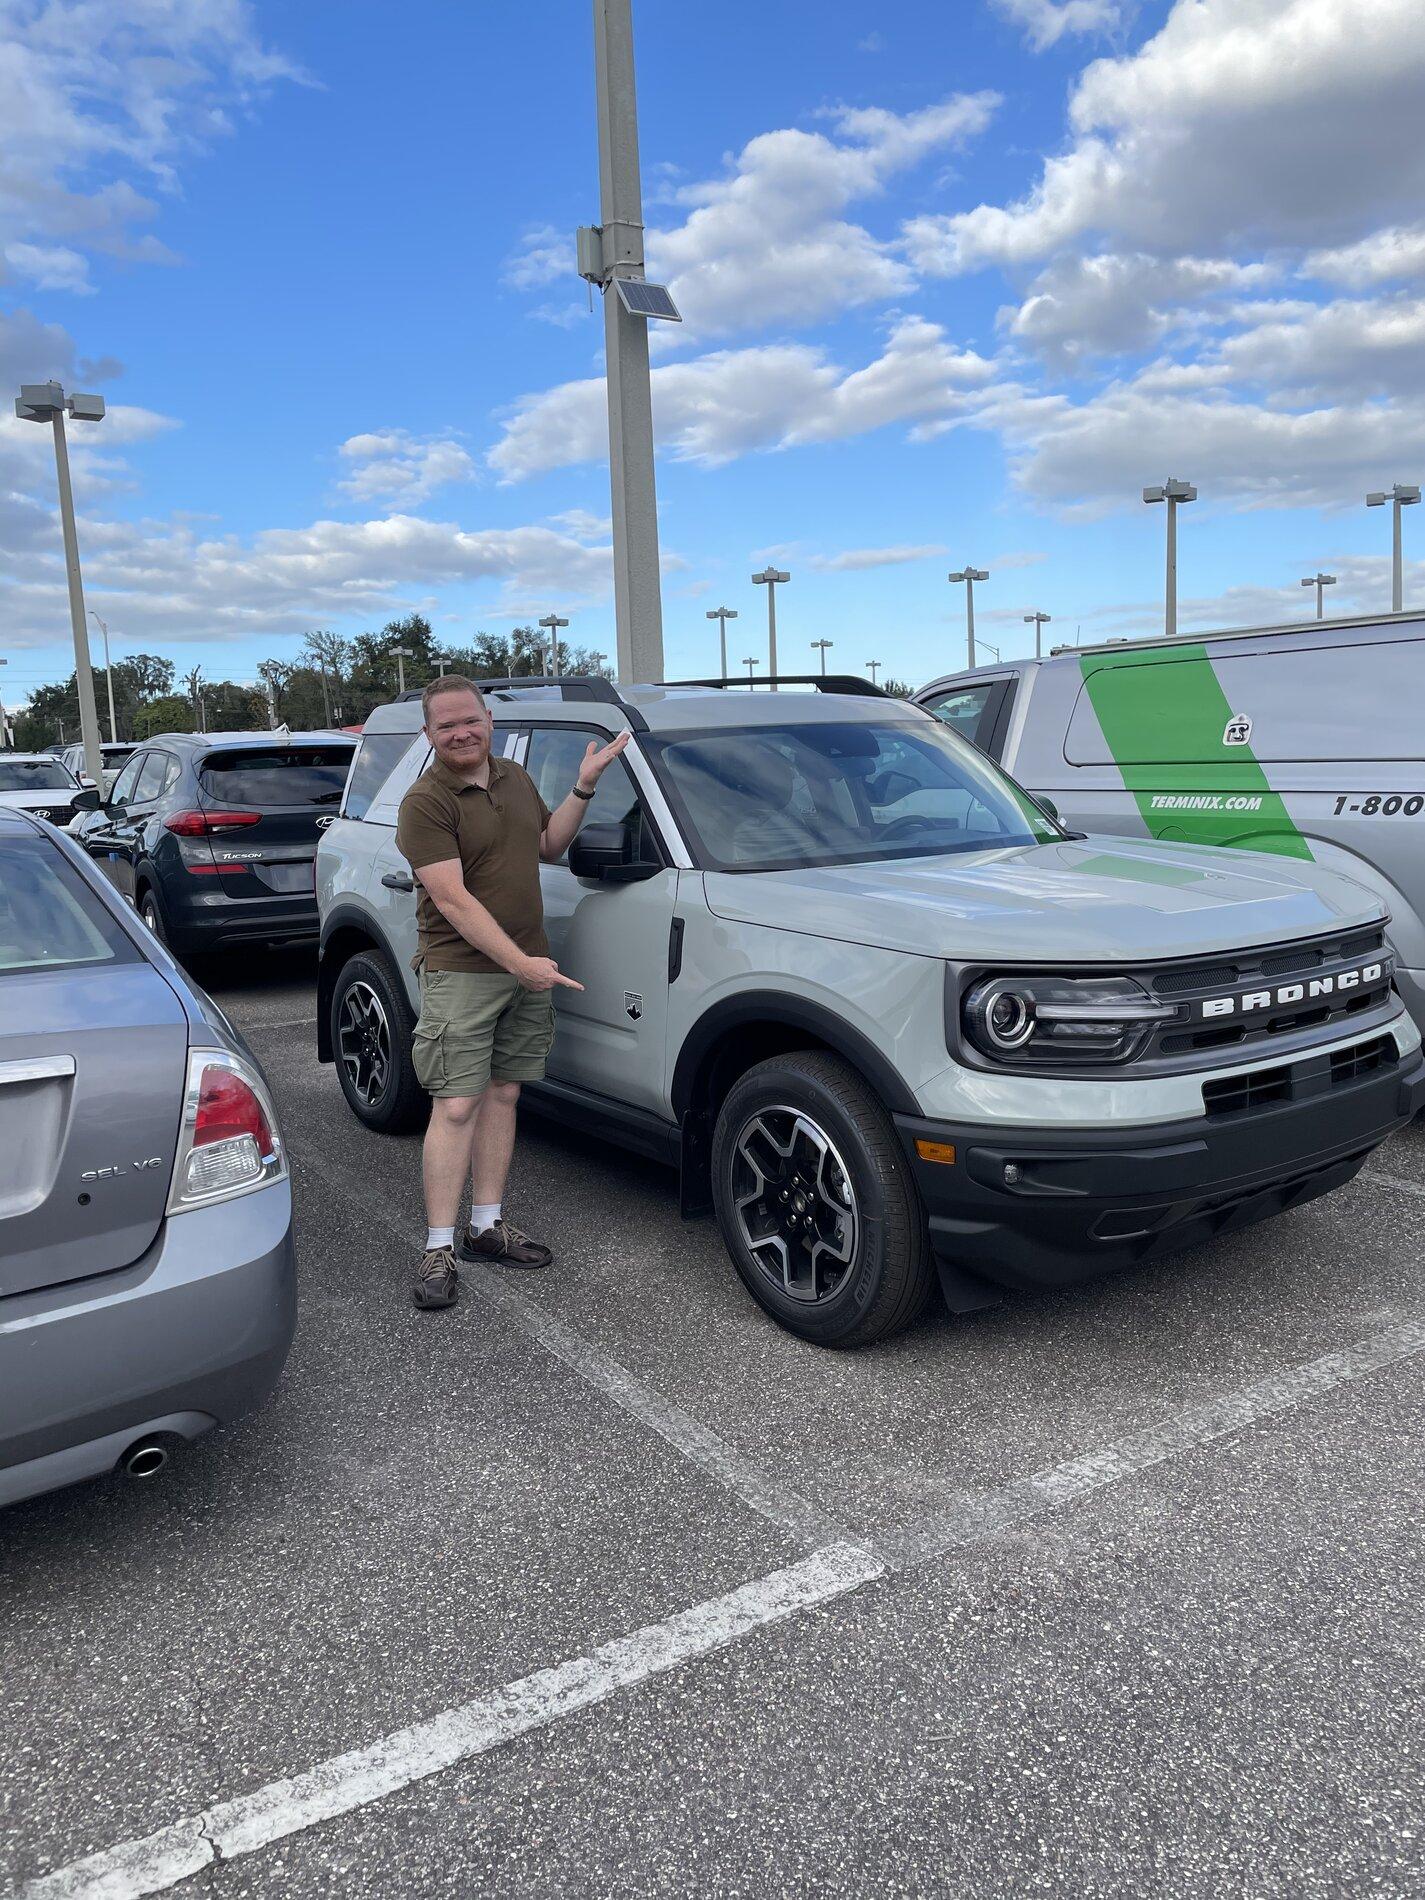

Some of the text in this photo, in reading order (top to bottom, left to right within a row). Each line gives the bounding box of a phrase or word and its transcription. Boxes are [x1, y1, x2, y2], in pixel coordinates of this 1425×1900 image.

[1150, 795, 1262, 810] TERMINIX.COM
[1202, 963, 1382, 1018] BRONCO
[81, 1157, 162, 1182] SEL V6
